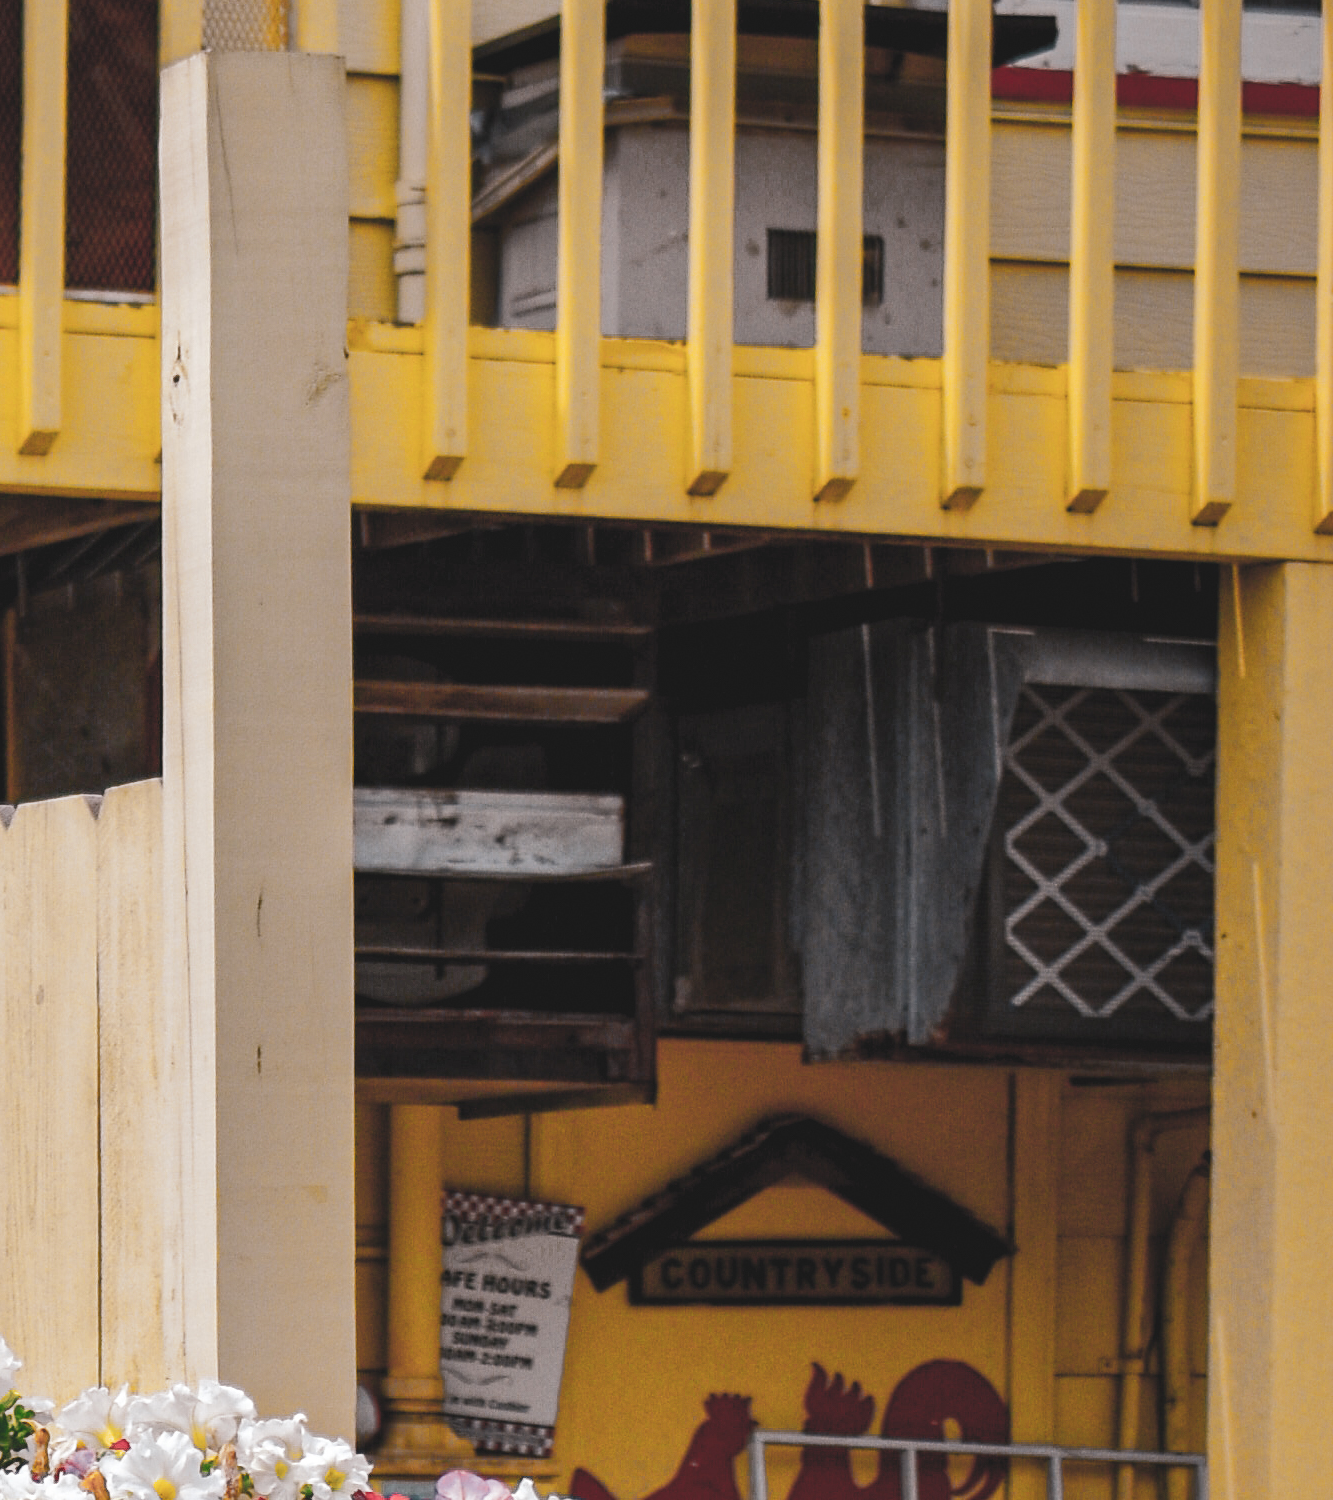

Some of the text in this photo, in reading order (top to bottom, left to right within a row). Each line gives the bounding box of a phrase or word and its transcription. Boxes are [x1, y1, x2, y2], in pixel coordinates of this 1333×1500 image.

[440, 1269, 551, 1299] AFE HOURS
[659, 1256, 935, 1290] COUNTRYSIDE
